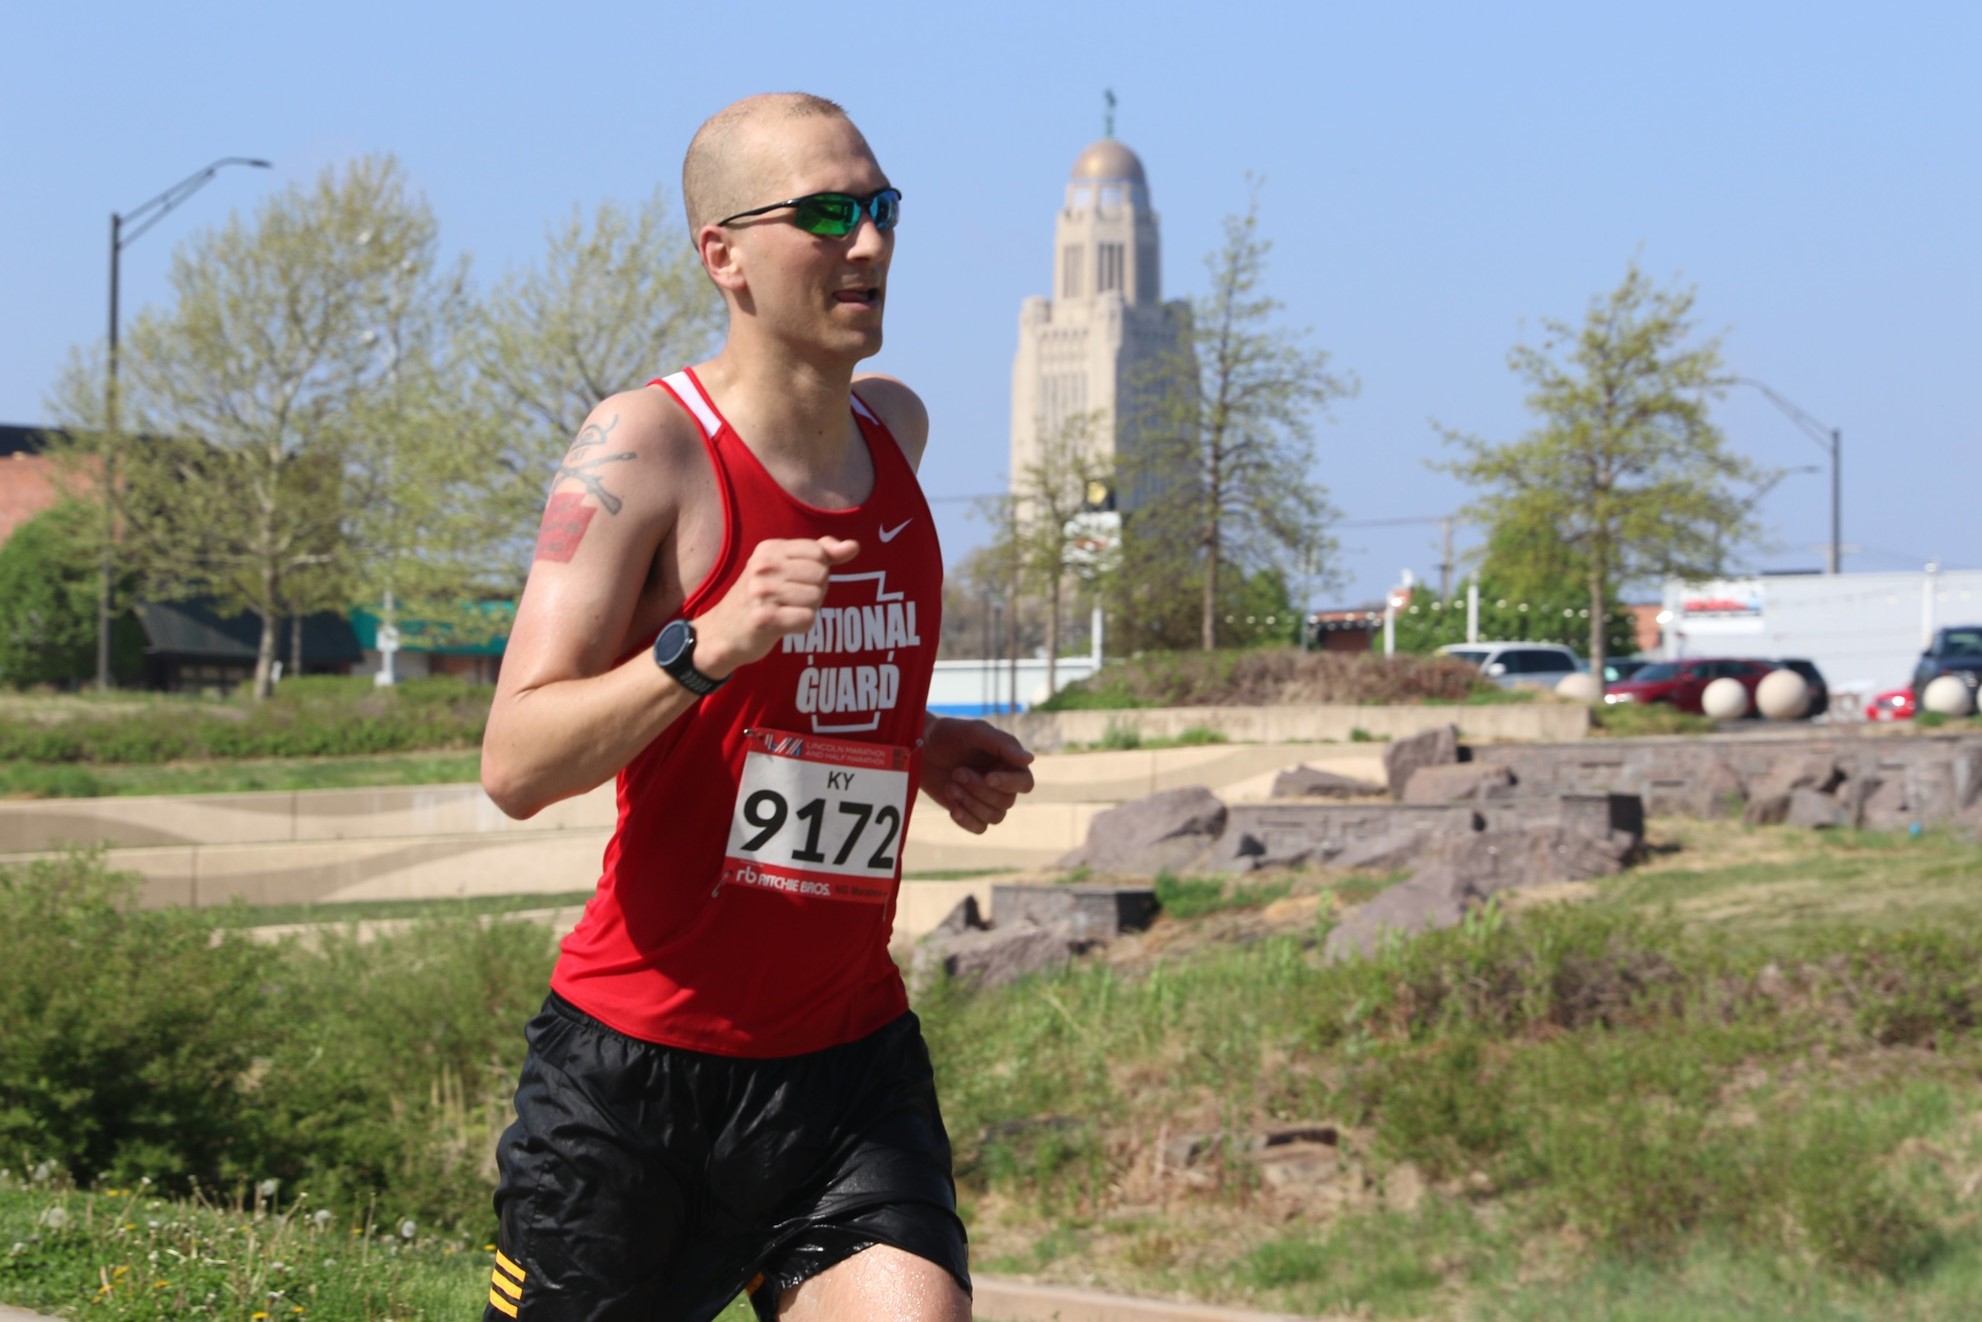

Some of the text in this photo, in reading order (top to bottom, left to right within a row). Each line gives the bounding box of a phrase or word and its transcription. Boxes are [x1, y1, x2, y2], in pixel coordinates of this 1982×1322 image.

[795, 664, 900, 714] GUARD
[806, 742, 844, 753] LINCOLN
[827, 771, 855, 790] KY
[740, 789, 900, 869] 9172
[736, 866, 757, 884] rb
[758, 873, 800, 891] RITCHIE
